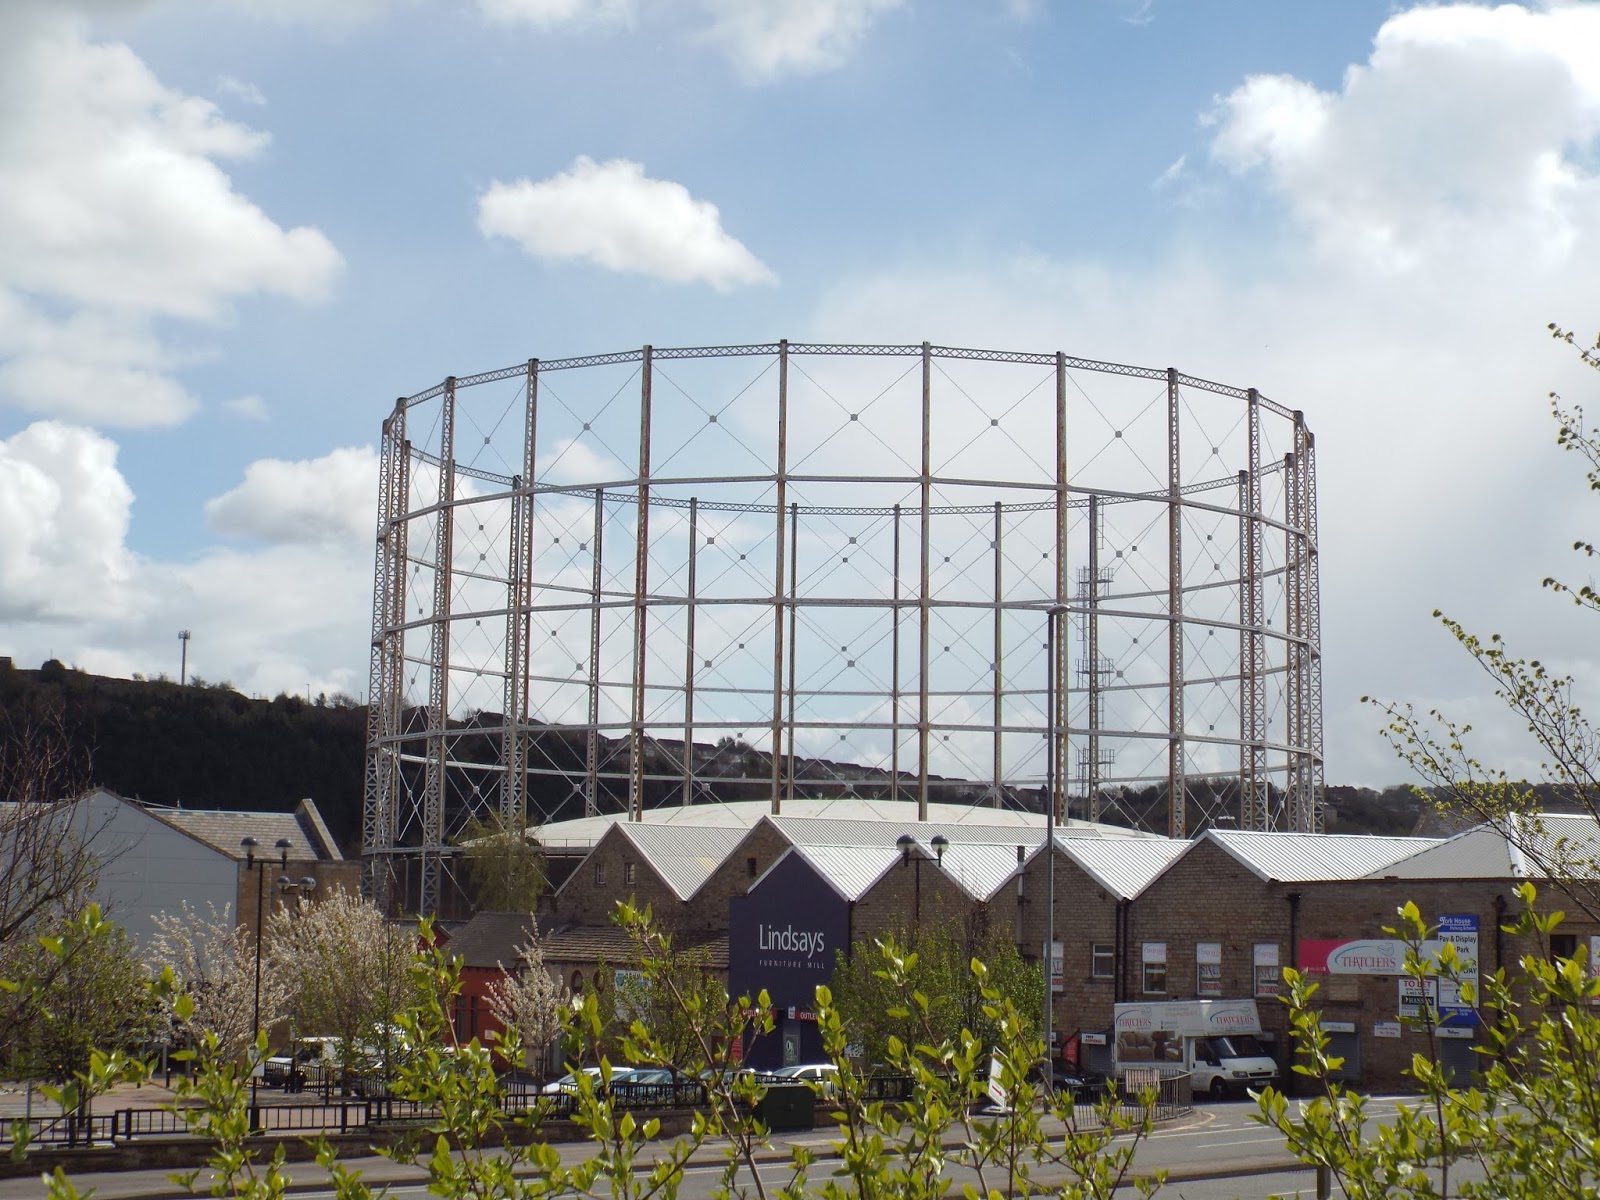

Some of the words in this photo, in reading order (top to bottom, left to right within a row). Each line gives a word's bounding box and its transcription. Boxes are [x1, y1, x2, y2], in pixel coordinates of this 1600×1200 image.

[759, 924, 825, 959] Lindsays
[1455, 935, 1477, 944] Display
[1456, 946, 1470, 954] Park
[759, 960, 801, 968] FURNITURE
[1341, 956, 1396, 971] THATCHERS
[1403, 980, 1415, 988] TO
